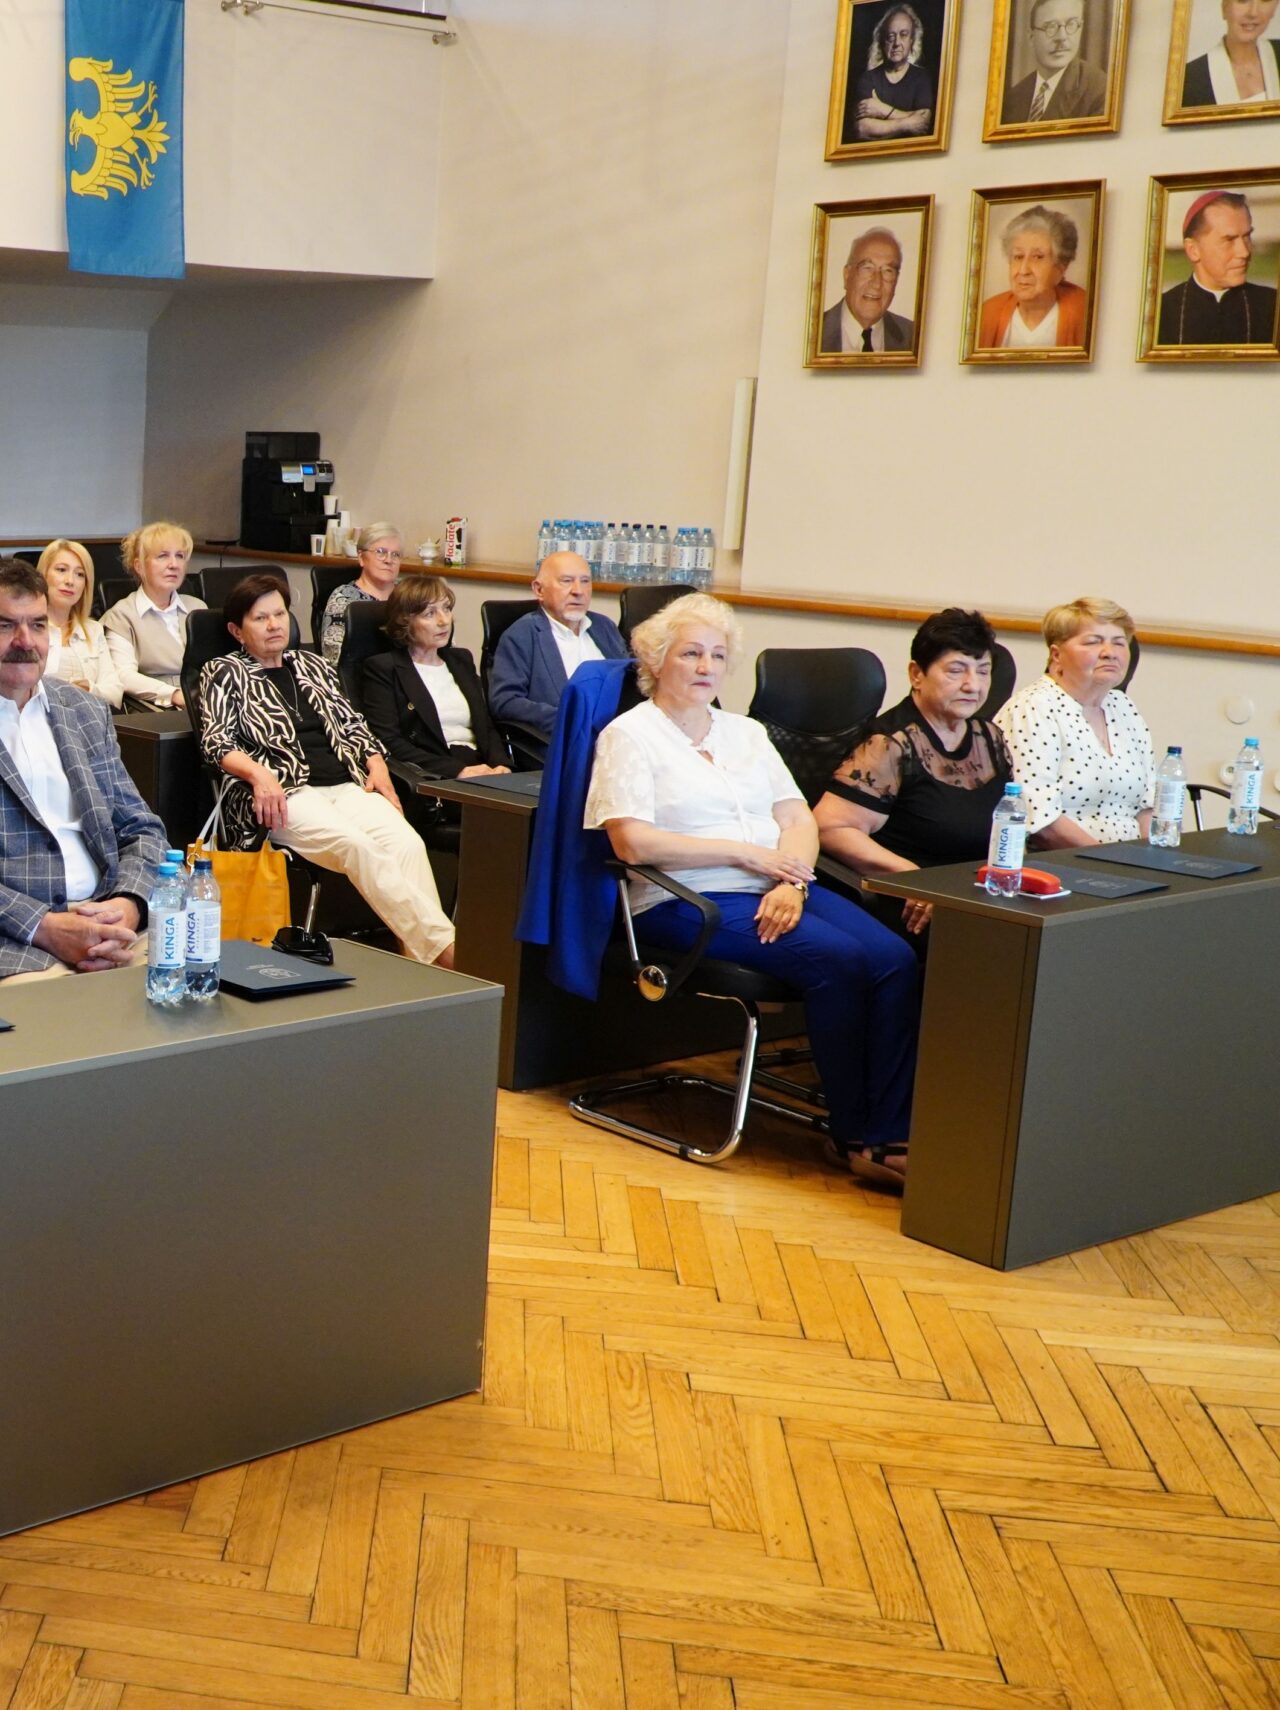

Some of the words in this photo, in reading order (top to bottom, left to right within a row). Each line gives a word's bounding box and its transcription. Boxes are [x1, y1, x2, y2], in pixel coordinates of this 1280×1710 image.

[1246, 774, 1256, 804] KINGA
[998, 827, 1009, 862] KINGA
[165, 917, 175, 960] KINGA
[187, 911, 196, 954] KINGA
